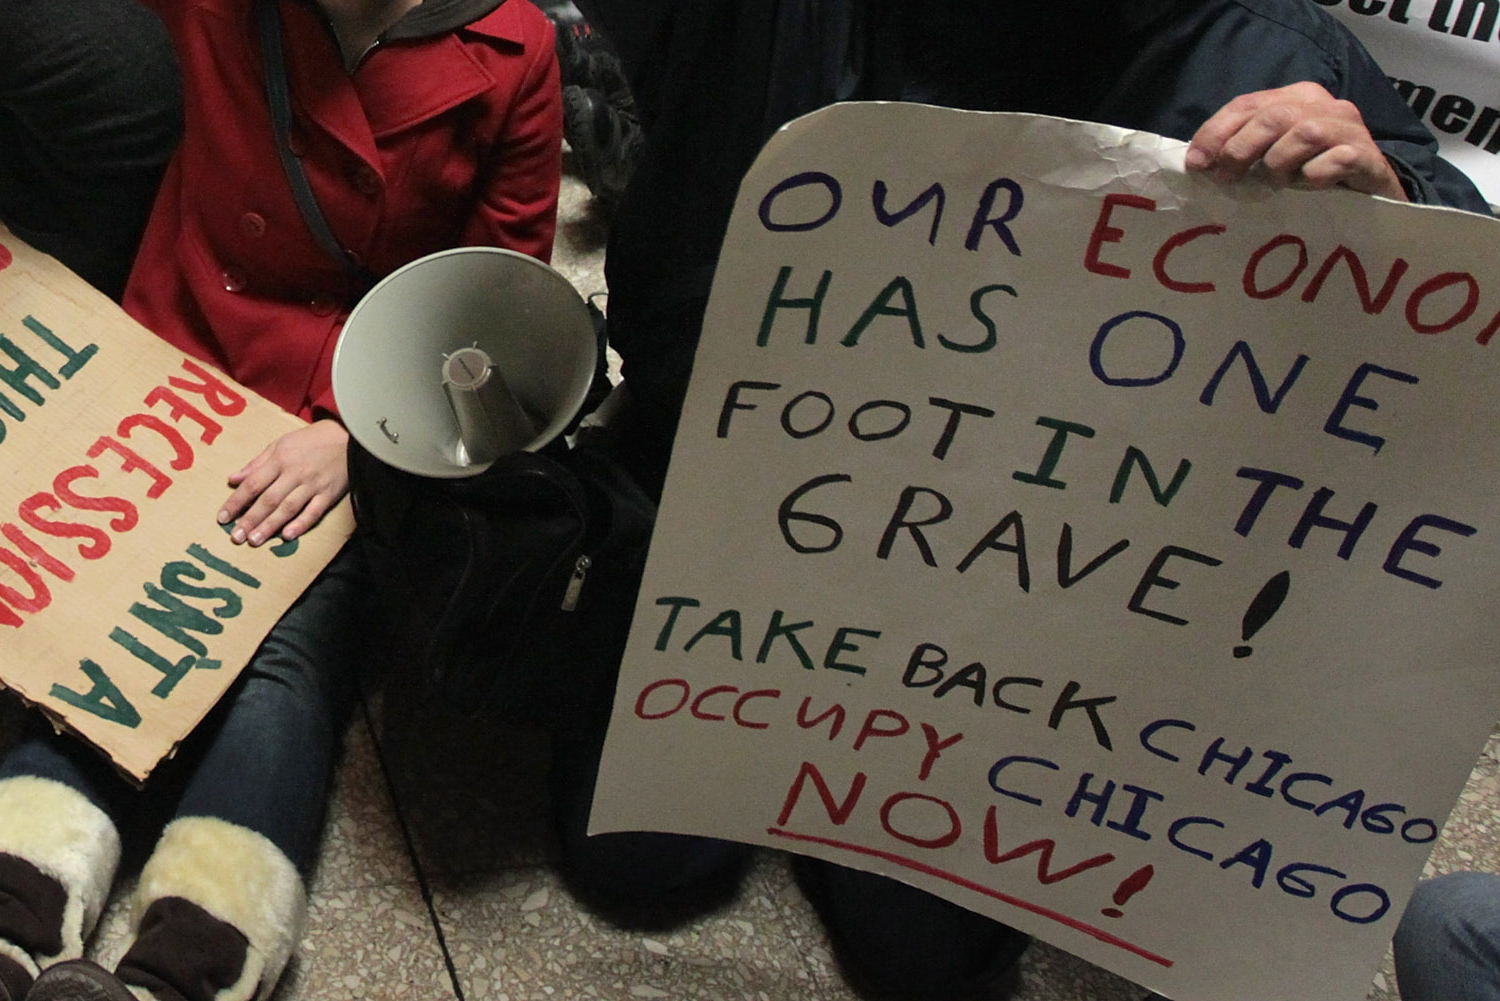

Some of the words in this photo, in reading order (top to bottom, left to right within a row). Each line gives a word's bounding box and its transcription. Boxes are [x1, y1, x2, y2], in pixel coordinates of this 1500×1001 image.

[758, 170, 1026, 256] OUR
[1083, 193, 1500, 346] ECONO
[756, 265, 1017, 354] HAS
[1089, 310, 1420, 457] ONE
[716, 380, 996, 460] FOOT
[1011, 416, 1194, 509] IN
[1233, 466, 1479, 590] THE
[49, 657, 143, 729] A
[653, 596, 882, 675] TAKE
[902, 643, 1118, 751] BACK
[1139, 719, 1439, 844] CHICAGO
[634, 678, 965, 781] OCCUPY
[988, 755, 1392, 925] CHICAGO
[776, 761, 1156, 919] NOW!
